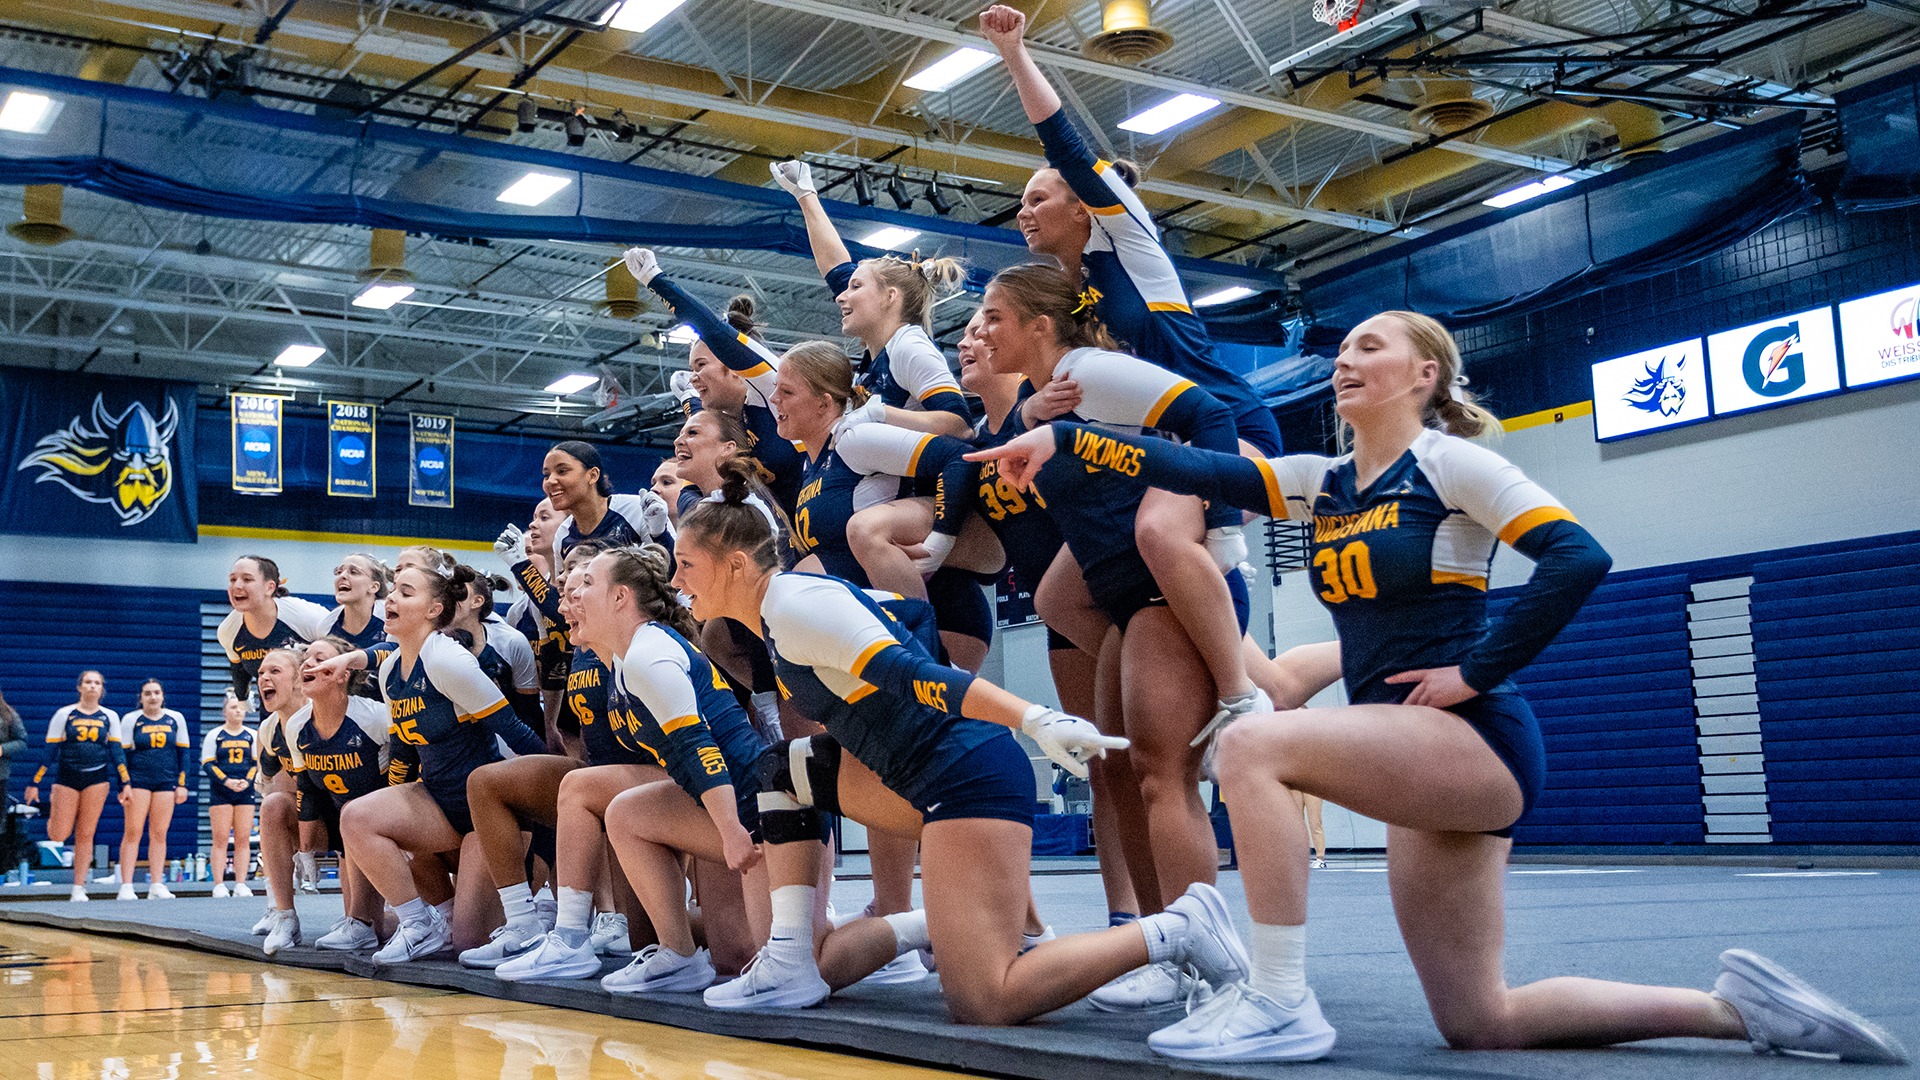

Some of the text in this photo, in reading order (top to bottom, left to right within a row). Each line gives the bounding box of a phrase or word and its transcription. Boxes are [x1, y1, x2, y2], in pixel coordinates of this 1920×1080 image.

[240, 397, 275, 411] 2016
[336, 404, 368, 418] 2018
[416, 416, 447, 430] 2019
[244, 441, 271, 452] NCAA
[340, 448, 365, 459] NCAA
[1074, 428, 1146, 477] VIKINGS
[419, 460, 445, 469] NCAA
[979, 476, 1028, 521] 39
[1313, 541, 1378, 604] 30
[521, 563, 550, 604] VIKINGS
[569, 693, 595, 726] 16
[76, 727, 99, 742] 34
[150, 732, 167, 748] 19
[229, 748, 244, 764] 13
